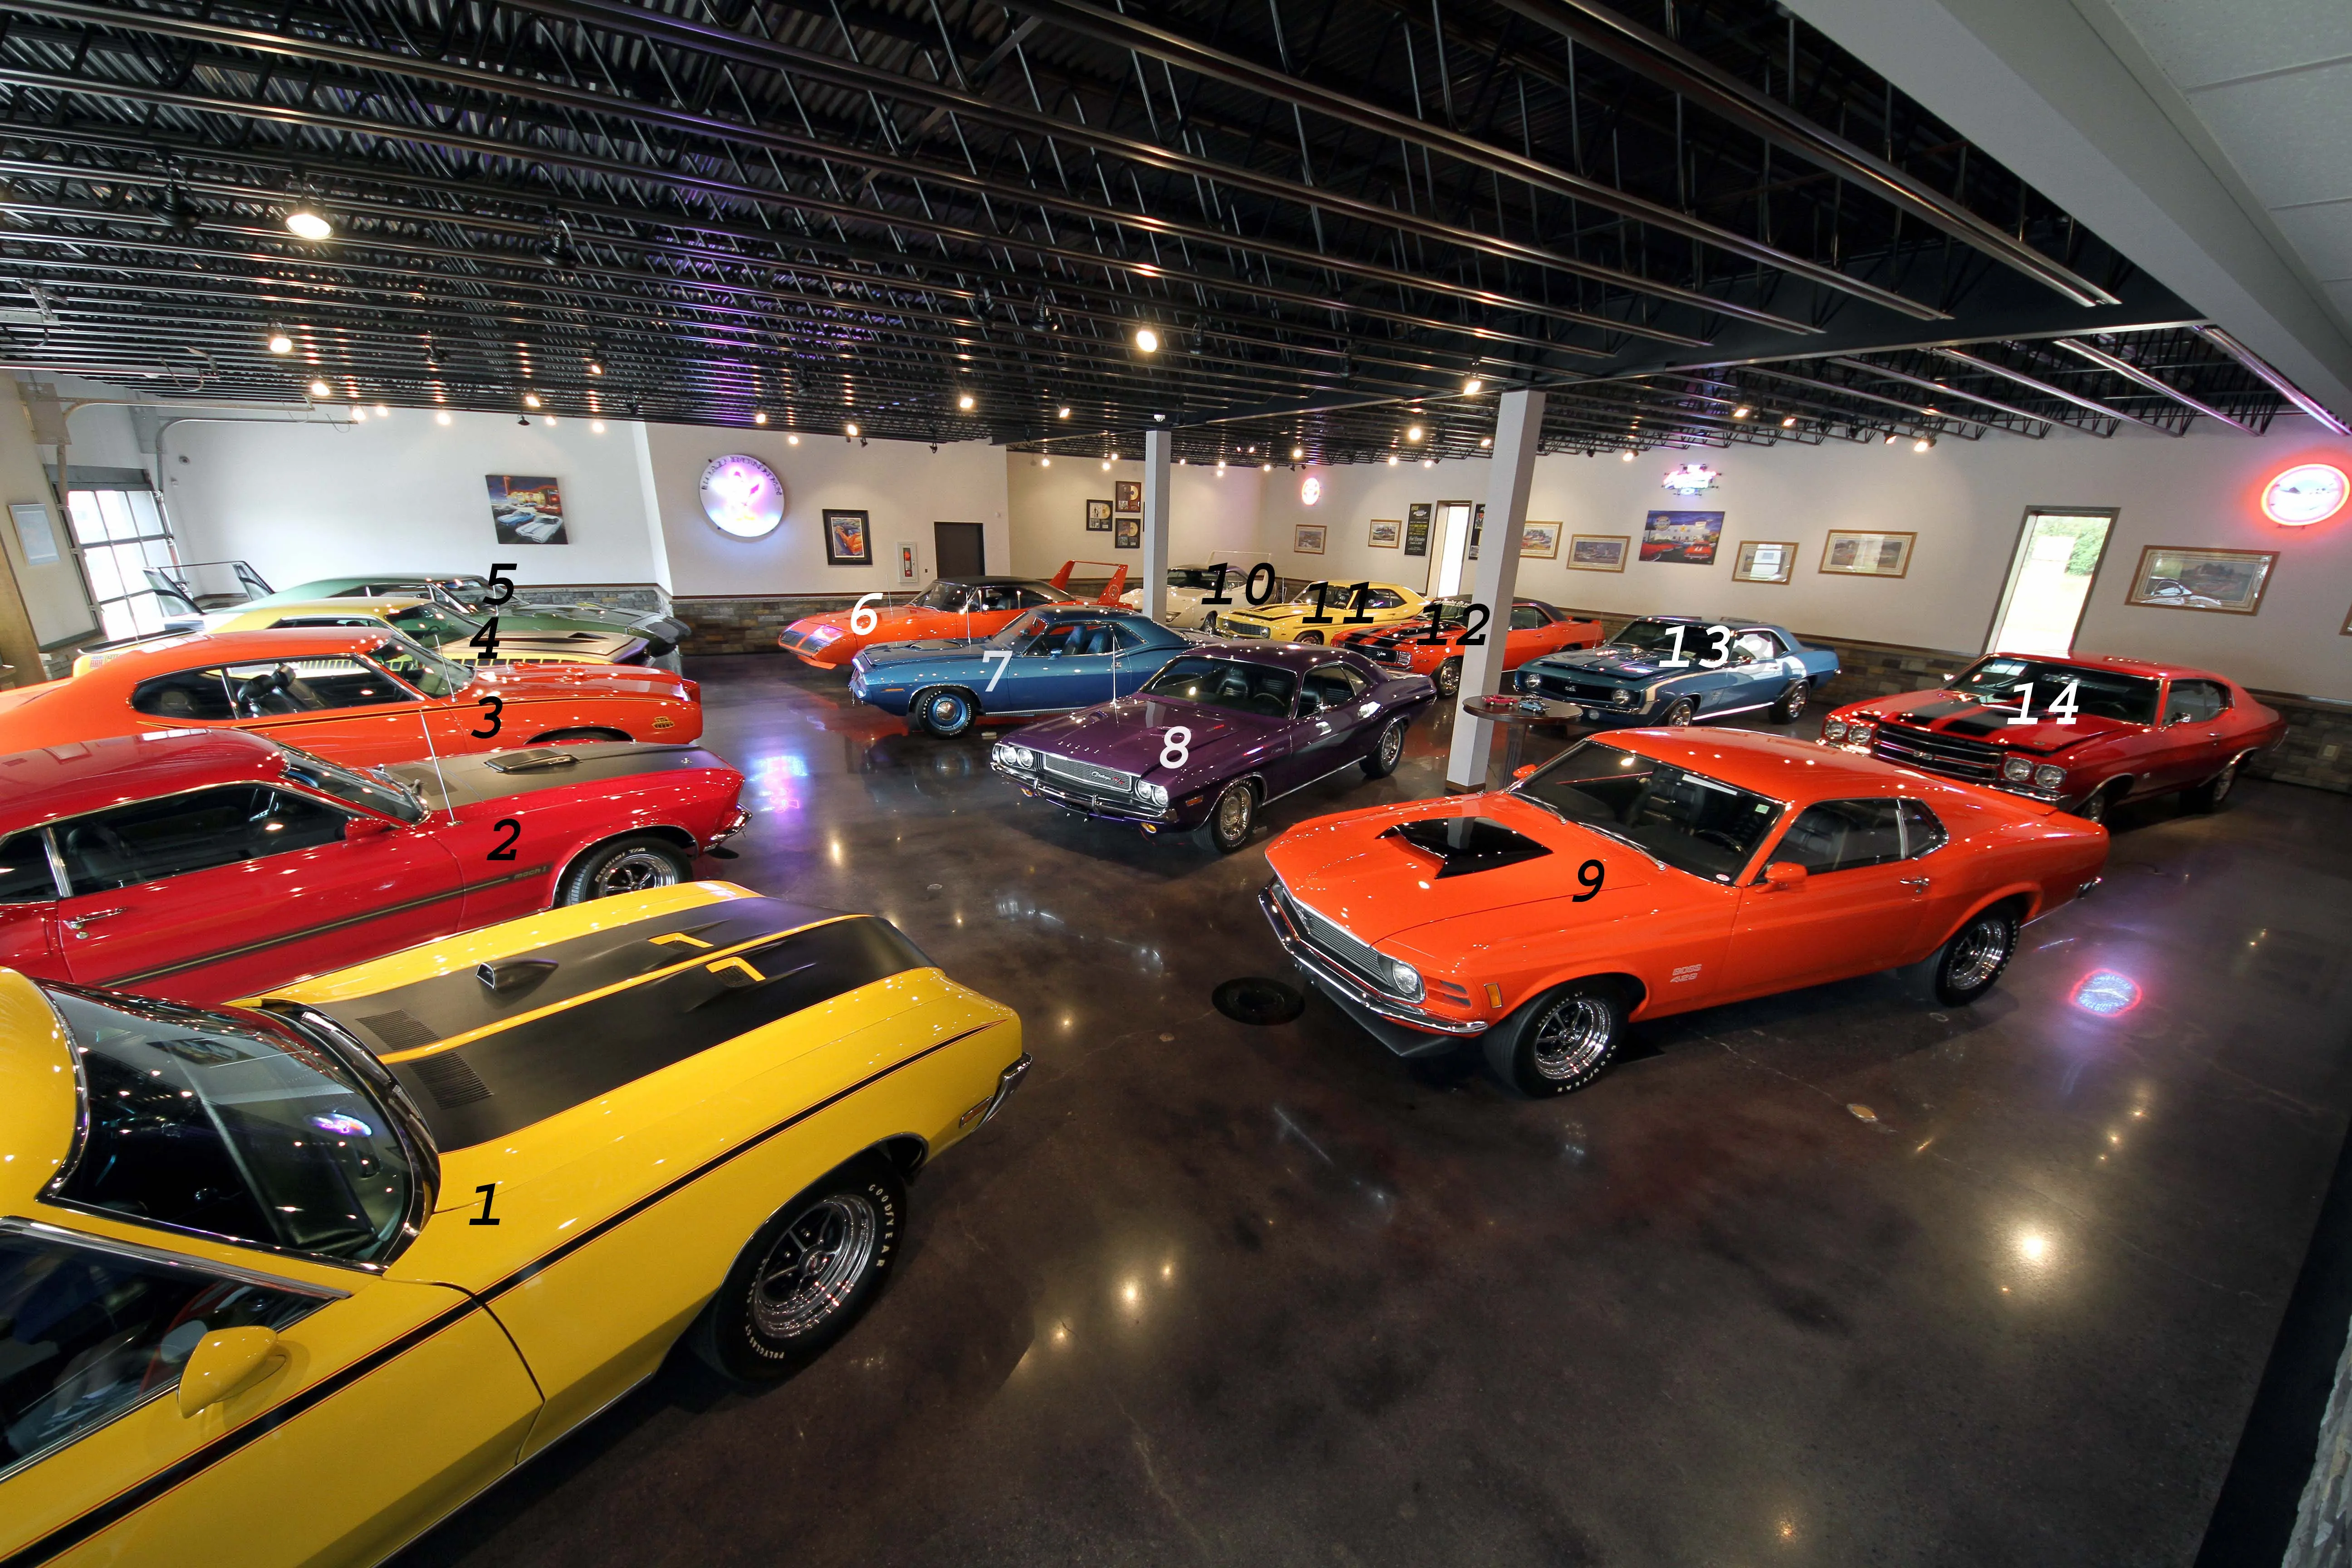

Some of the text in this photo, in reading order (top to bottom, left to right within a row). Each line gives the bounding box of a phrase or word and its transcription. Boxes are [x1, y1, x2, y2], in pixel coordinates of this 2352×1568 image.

[594, 852, 625, 882] Radial
[1670, 973, 1698, 983] 429
[1672, 964, 1702, 976] BOSS
[1557, 1045, 1617, 1093] GOODYEAR
[868, 1184, 894, 1267] GOODYEAR
[749, 1336, 785, 1359] POLYGLAS
